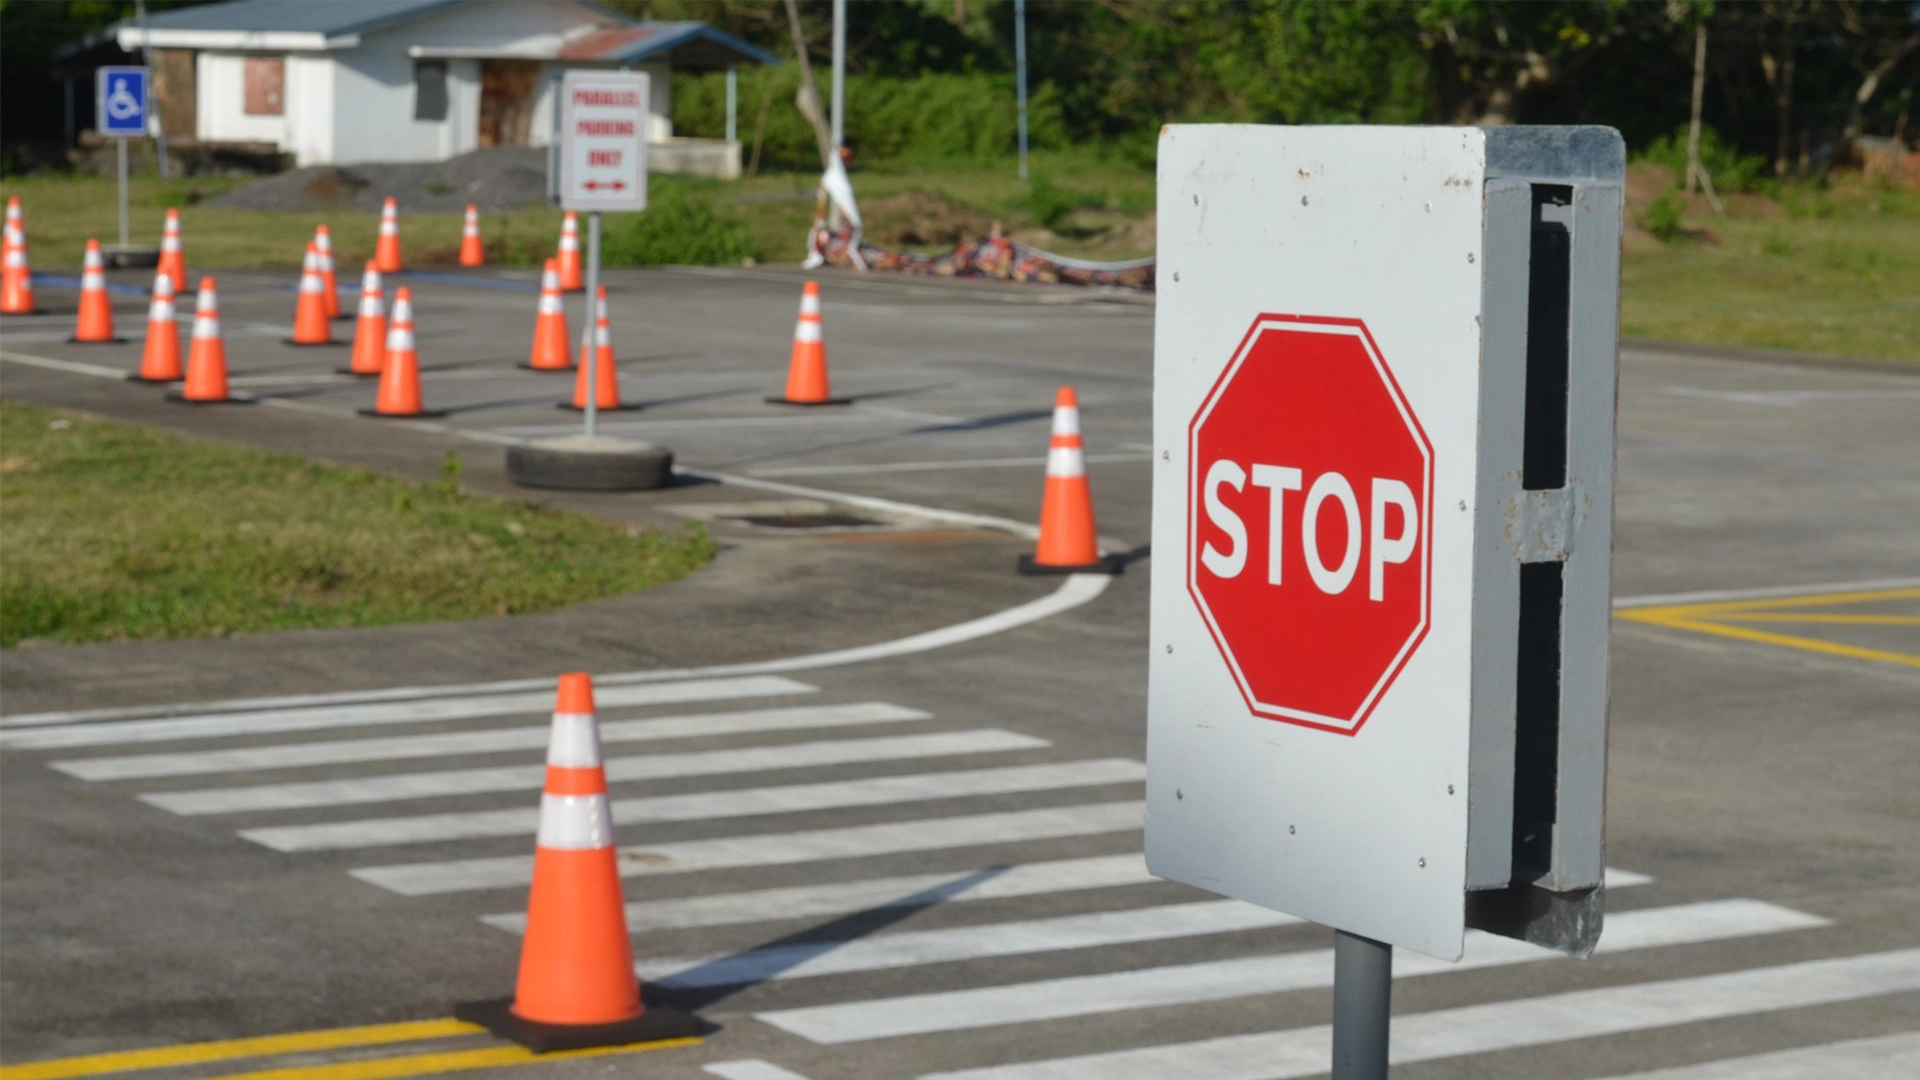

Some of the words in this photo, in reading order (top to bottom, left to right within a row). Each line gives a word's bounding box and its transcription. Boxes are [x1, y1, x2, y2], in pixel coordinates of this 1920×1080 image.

[577, 120, 634, 136] PARKING
[588, 149, 622, 167] ONLY
[1201, 459, 1418, 602] STOP
